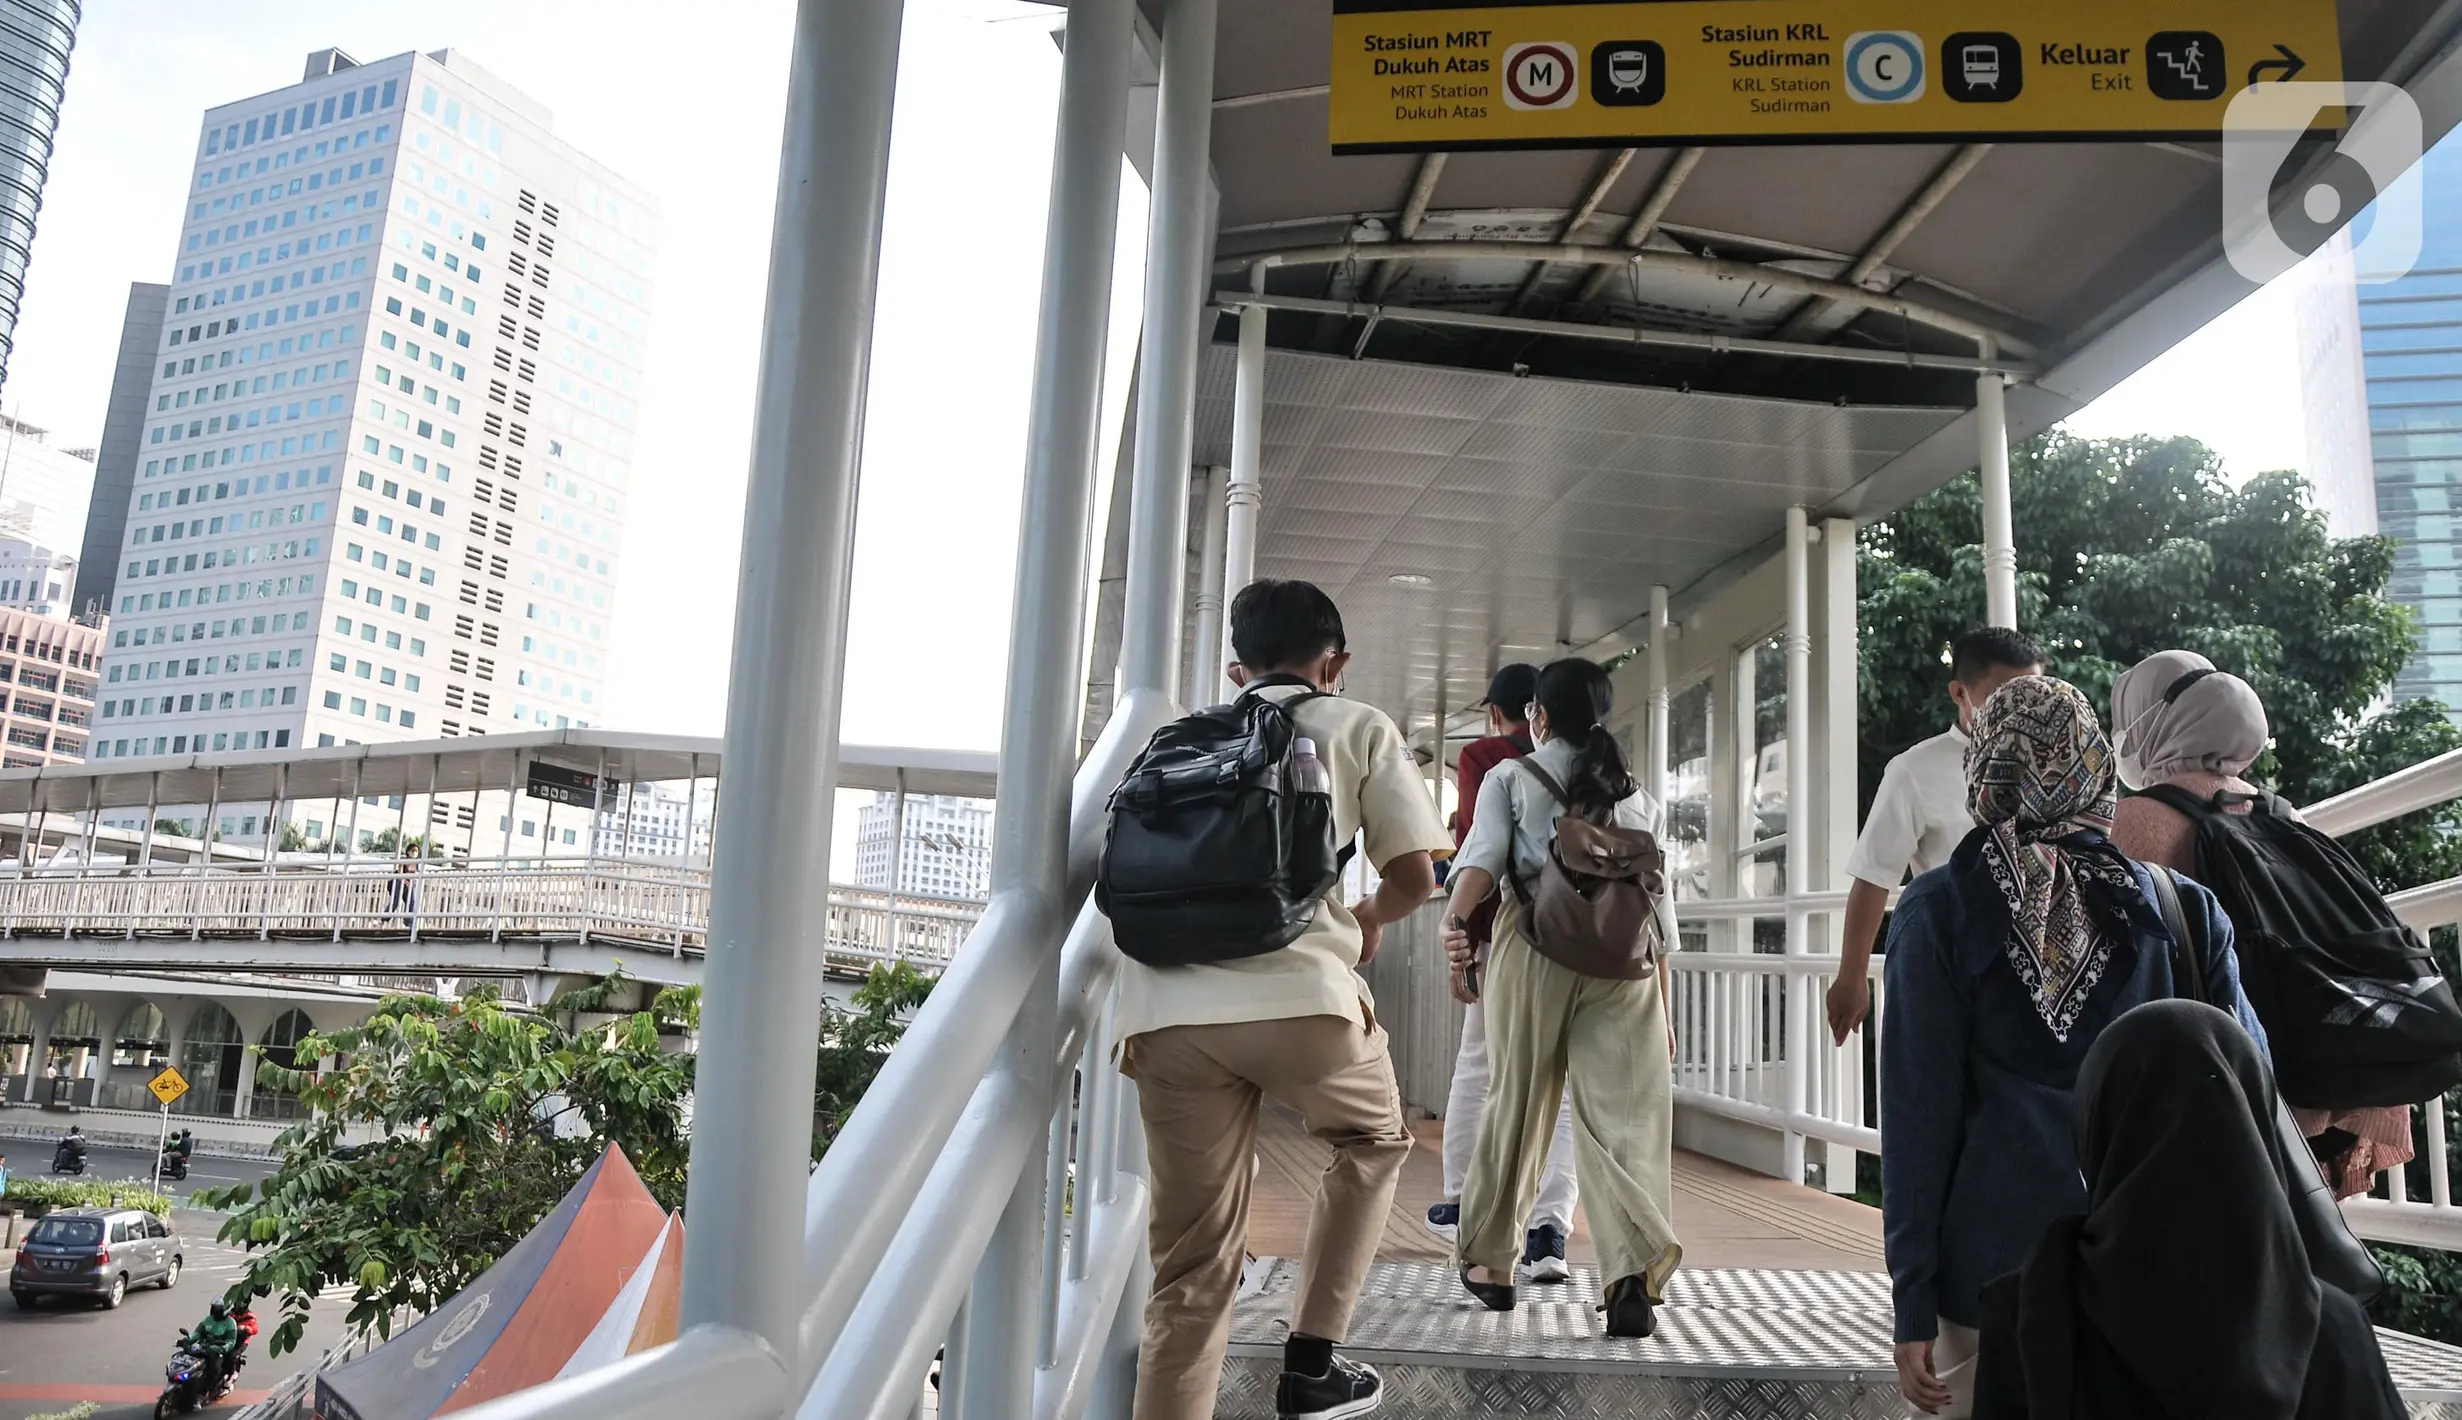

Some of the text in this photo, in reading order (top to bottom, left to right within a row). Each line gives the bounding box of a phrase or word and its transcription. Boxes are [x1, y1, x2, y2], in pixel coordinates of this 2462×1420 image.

[1364, 30, 1493, 52] Stasiun MRT
[1702, 23, 1830, 43] Stasiun KRL
[1728, 49, 1830, 67] Sudirman
[2041, 43, 2131, 65] Keluar
[1374, 56, 1490, 76] Dukuh Atas
[1529, 62, 1552, 86] M
[1875, 54, 1893, 81] C
[1391, 83, 1489, 100] MRT Station
[1732, 77, 1830, 92] KRL Station
[2091, 73, 2133, 91] Exit
[1395, 104, 1488, 121] Dukuh Atas
[1750, 97, 1830, 112] Sudirman
